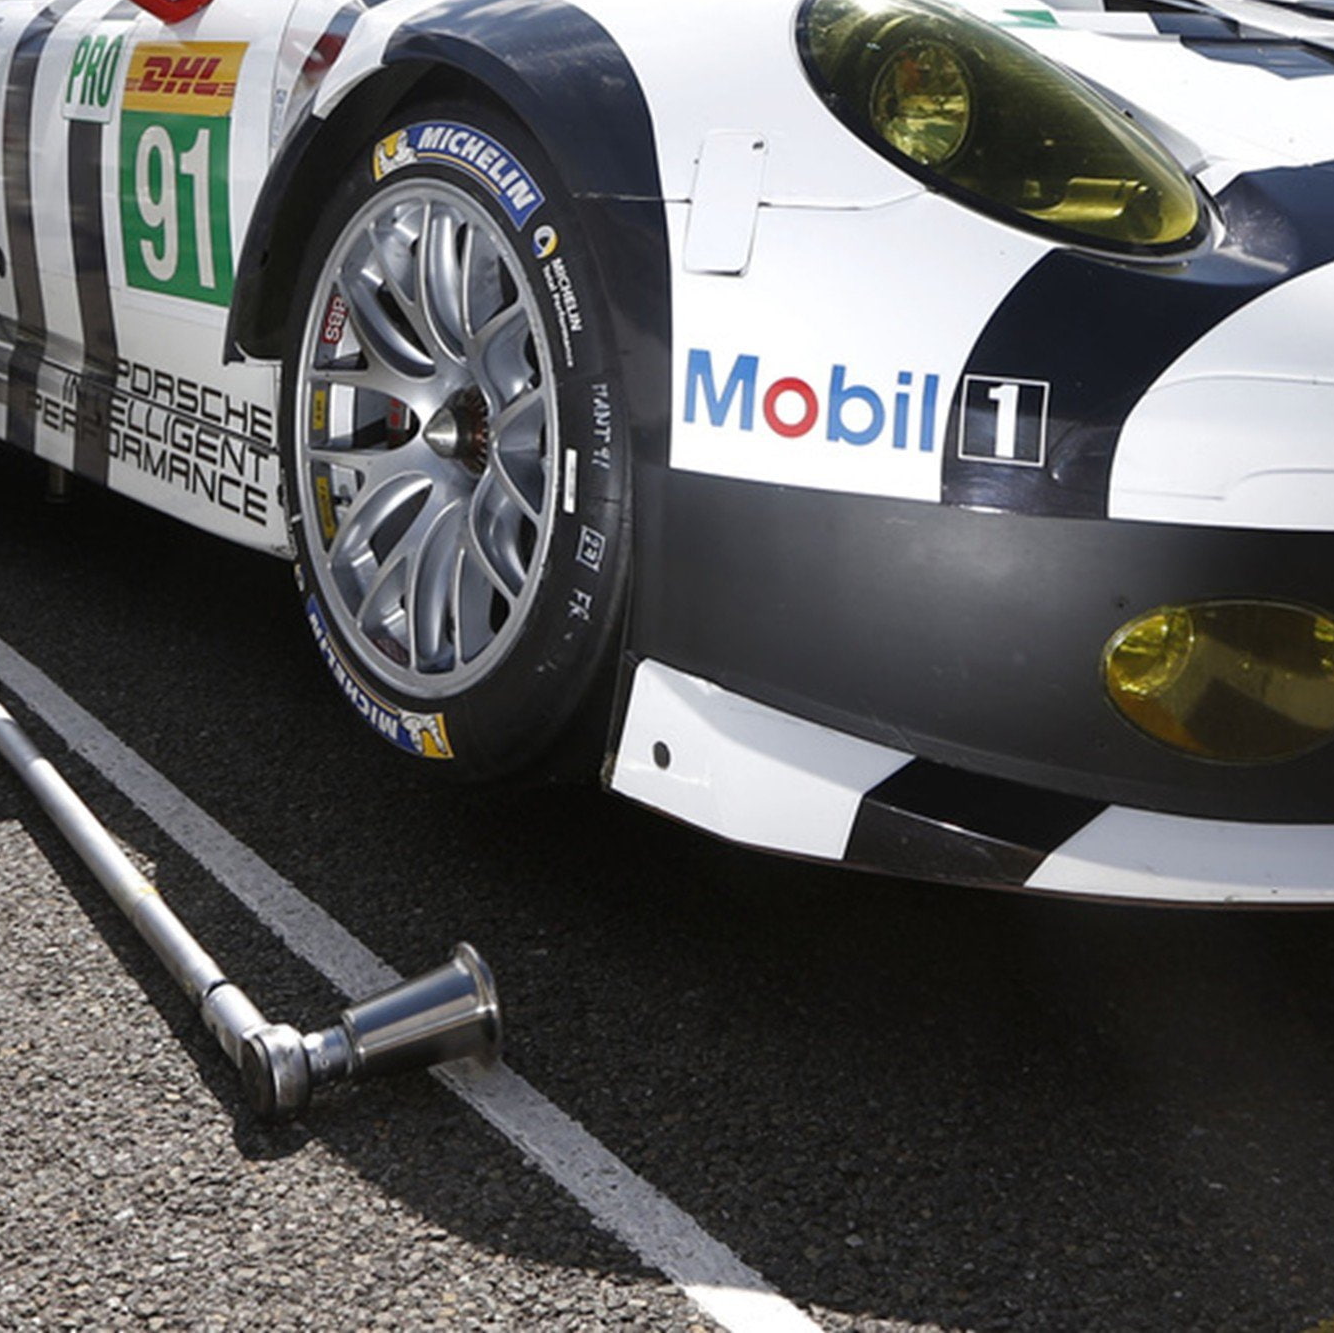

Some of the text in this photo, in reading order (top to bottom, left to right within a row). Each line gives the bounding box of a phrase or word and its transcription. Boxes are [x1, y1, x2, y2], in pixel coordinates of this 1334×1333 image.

[65, 34, 125, 108] PRO
[138, 55, 223, 97] DHL
[135, 124, 216, 289] 91
[418, 126, 536, 211] MICHELIN
[542, 264, 574, 367] Total Performance
[550, 257, 583, 332] MICHELIN
[116, 357, 273, 446] PORSCHE
[683, 348, 1020, 459] Mobil 1
[308, 613, 398, 740] MICHELIN
